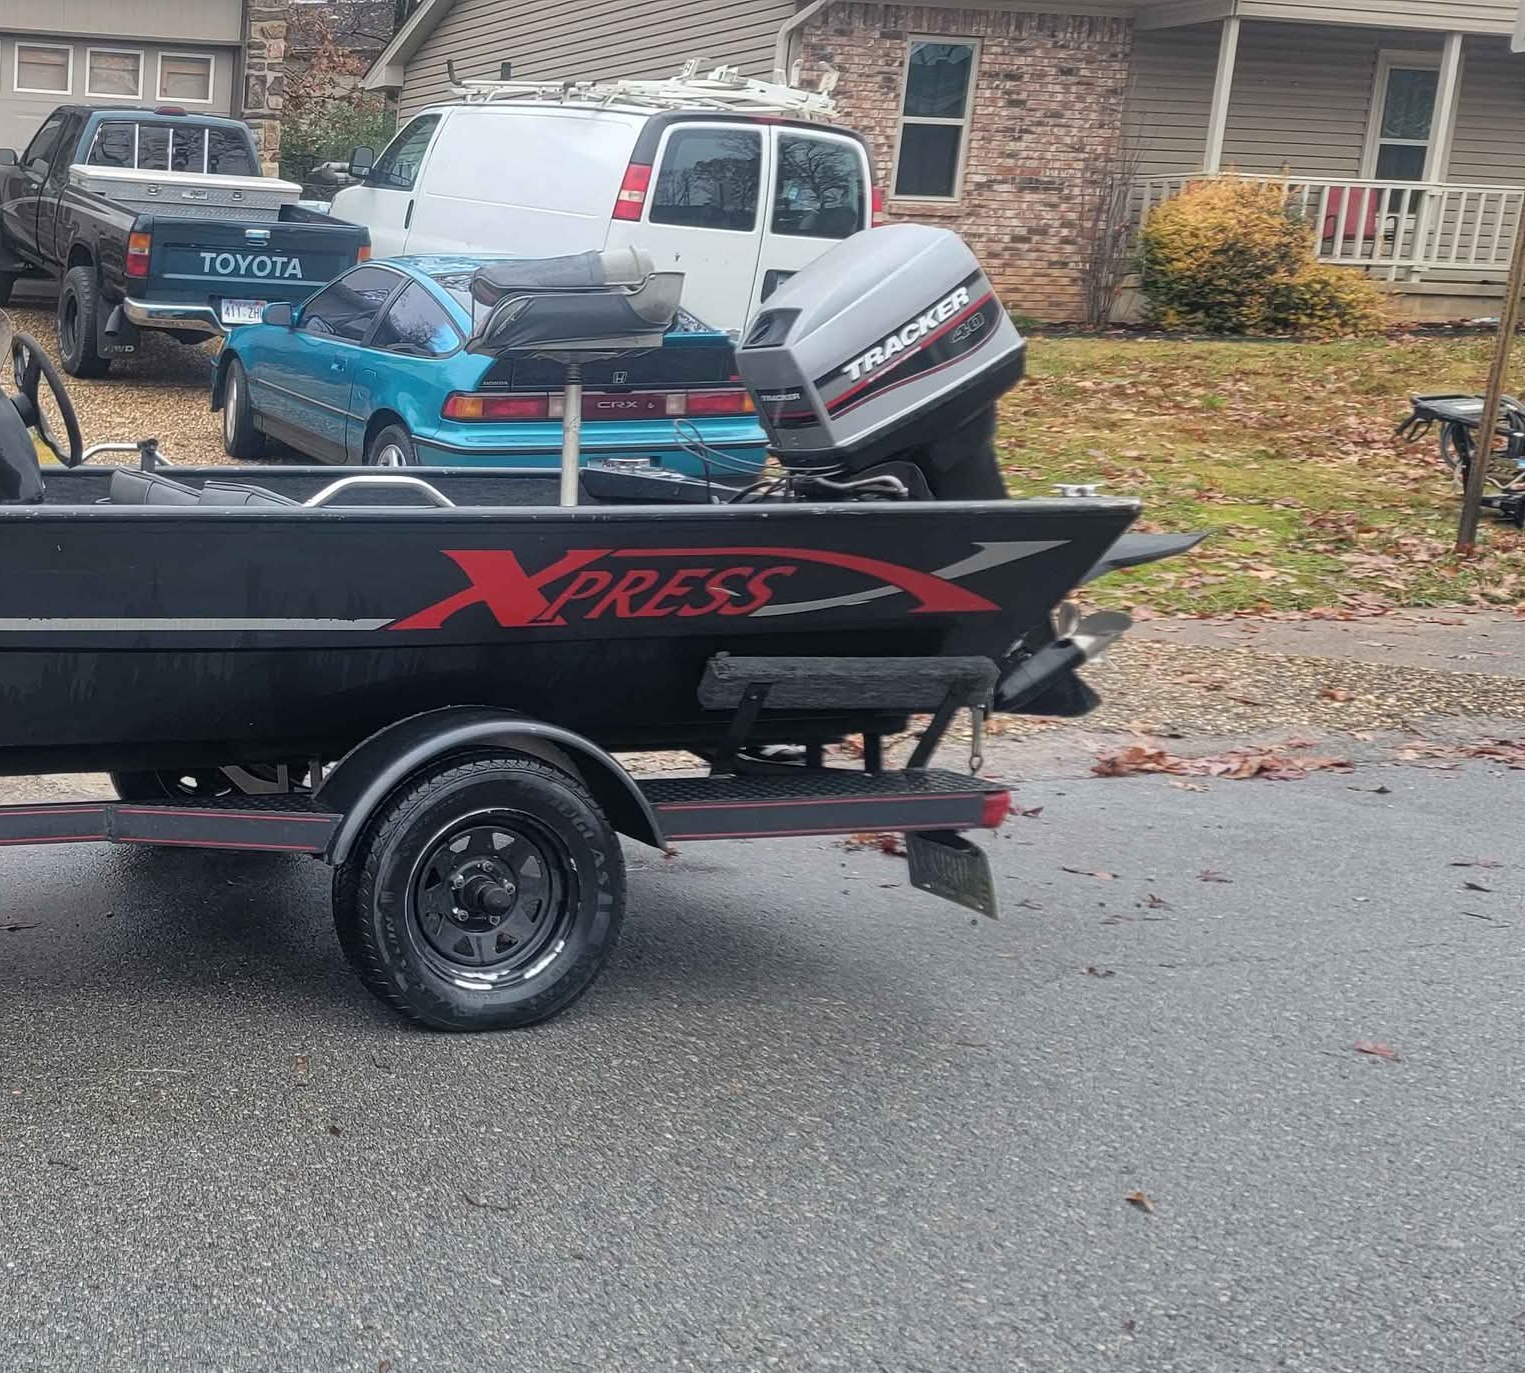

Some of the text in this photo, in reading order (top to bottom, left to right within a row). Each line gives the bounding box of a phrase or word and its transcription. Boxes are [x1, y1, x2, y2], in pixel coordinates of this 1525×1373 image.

[200, 252, 303, 279] TOYOTA
[842, 286, 971, 382] TRACKER
[951, 312, 986, 344] 40
[597, 401, 639, 409] CRX
[386, 548, 798, 628] XPRESS
